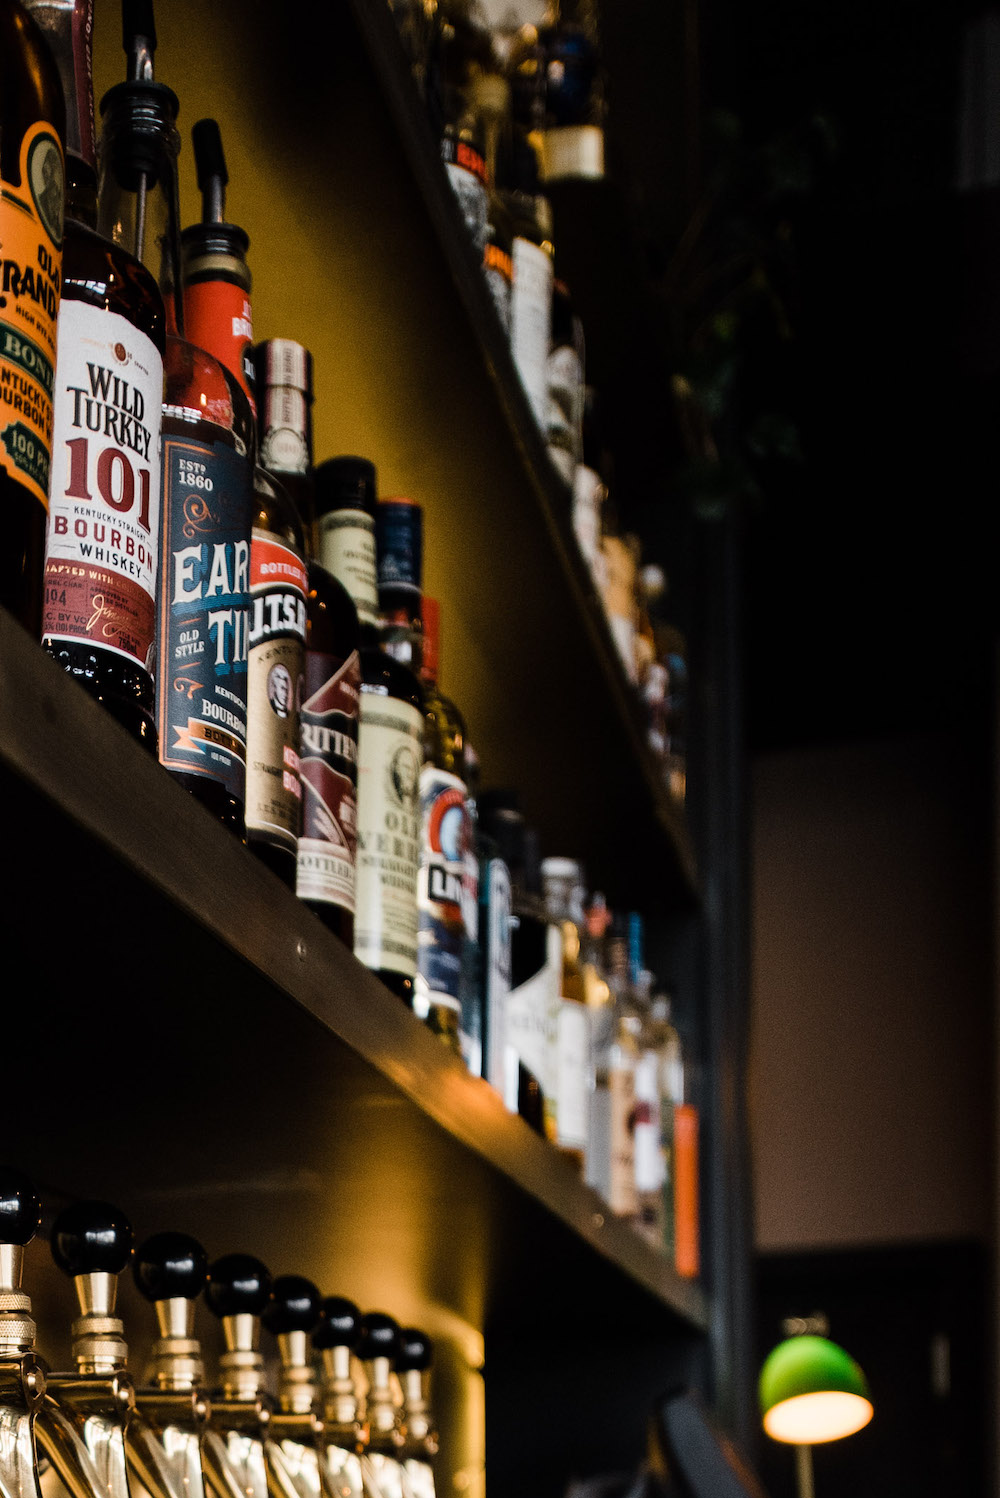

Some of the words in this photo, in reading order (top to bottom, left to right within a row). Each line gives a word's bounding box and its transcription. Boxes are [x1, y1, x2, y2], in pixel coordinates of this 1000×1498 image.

[38, 243, 60, 294] OLD
[86, 360, 145, 422] WILD
[66, 385, 152, 463] TURKEY
[12, 429, 35, 460] 100
[64, 437, 151, 536] 101
[178, 471, 214, 492] 1860
[73, 506, 116, 525] KENTUCKY
[118, 519, 146, 543] STRAIGHT
[54, 515, 153, 575] BOURBON
[80, 542, 142, 579] WHISKEY
[89, 570, 114, 585] WITH
[172, 539, 250, 605] EAR
[58, 611, 71, 622] BY
[175, 640, 204, 659] STYLE
[180, 629, 199, 644] OLD
